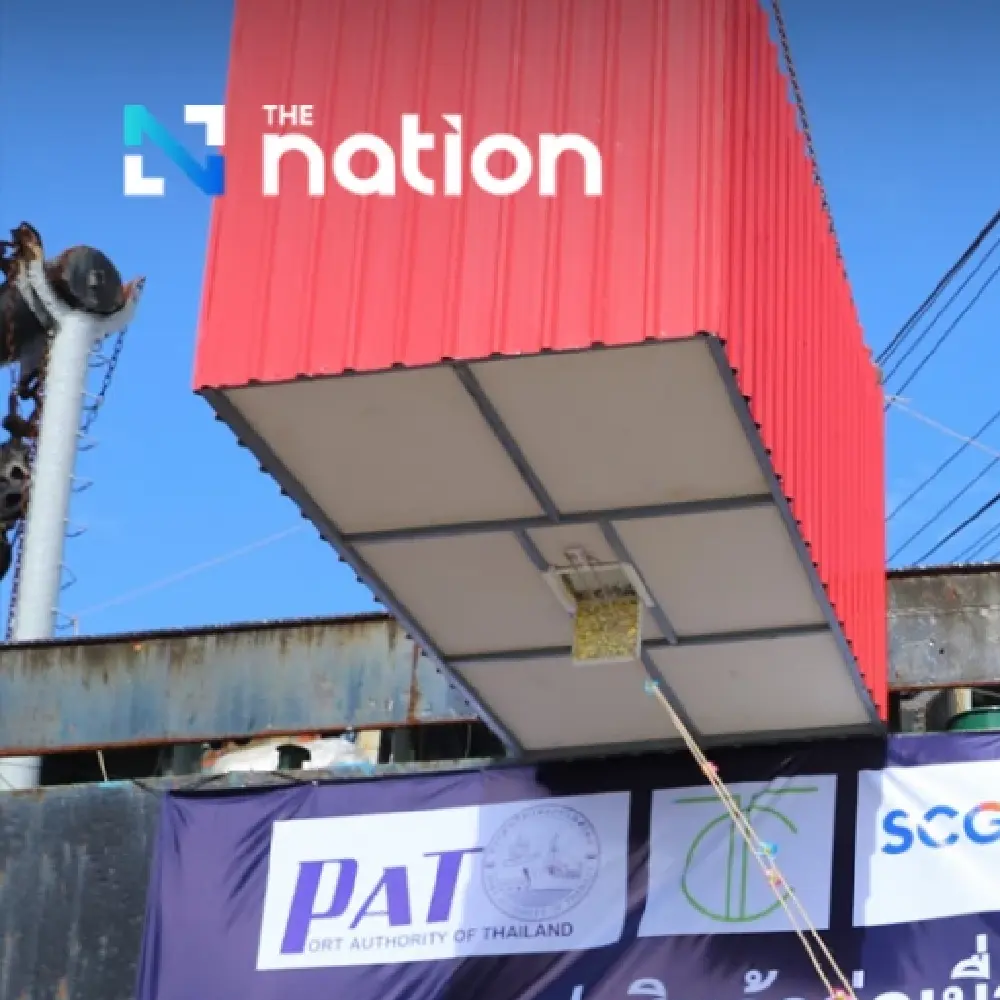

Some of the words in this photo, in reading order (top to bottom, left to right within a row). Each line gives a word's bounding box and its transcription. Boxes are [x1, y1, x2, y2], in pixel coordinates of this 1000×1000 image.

[279, 847, 483, 954] PAT
[349, 931, 448, 951] AUTHORITY
[454, 927, 478, 943] OF
[483, 922, 575, 942] THAILAND
